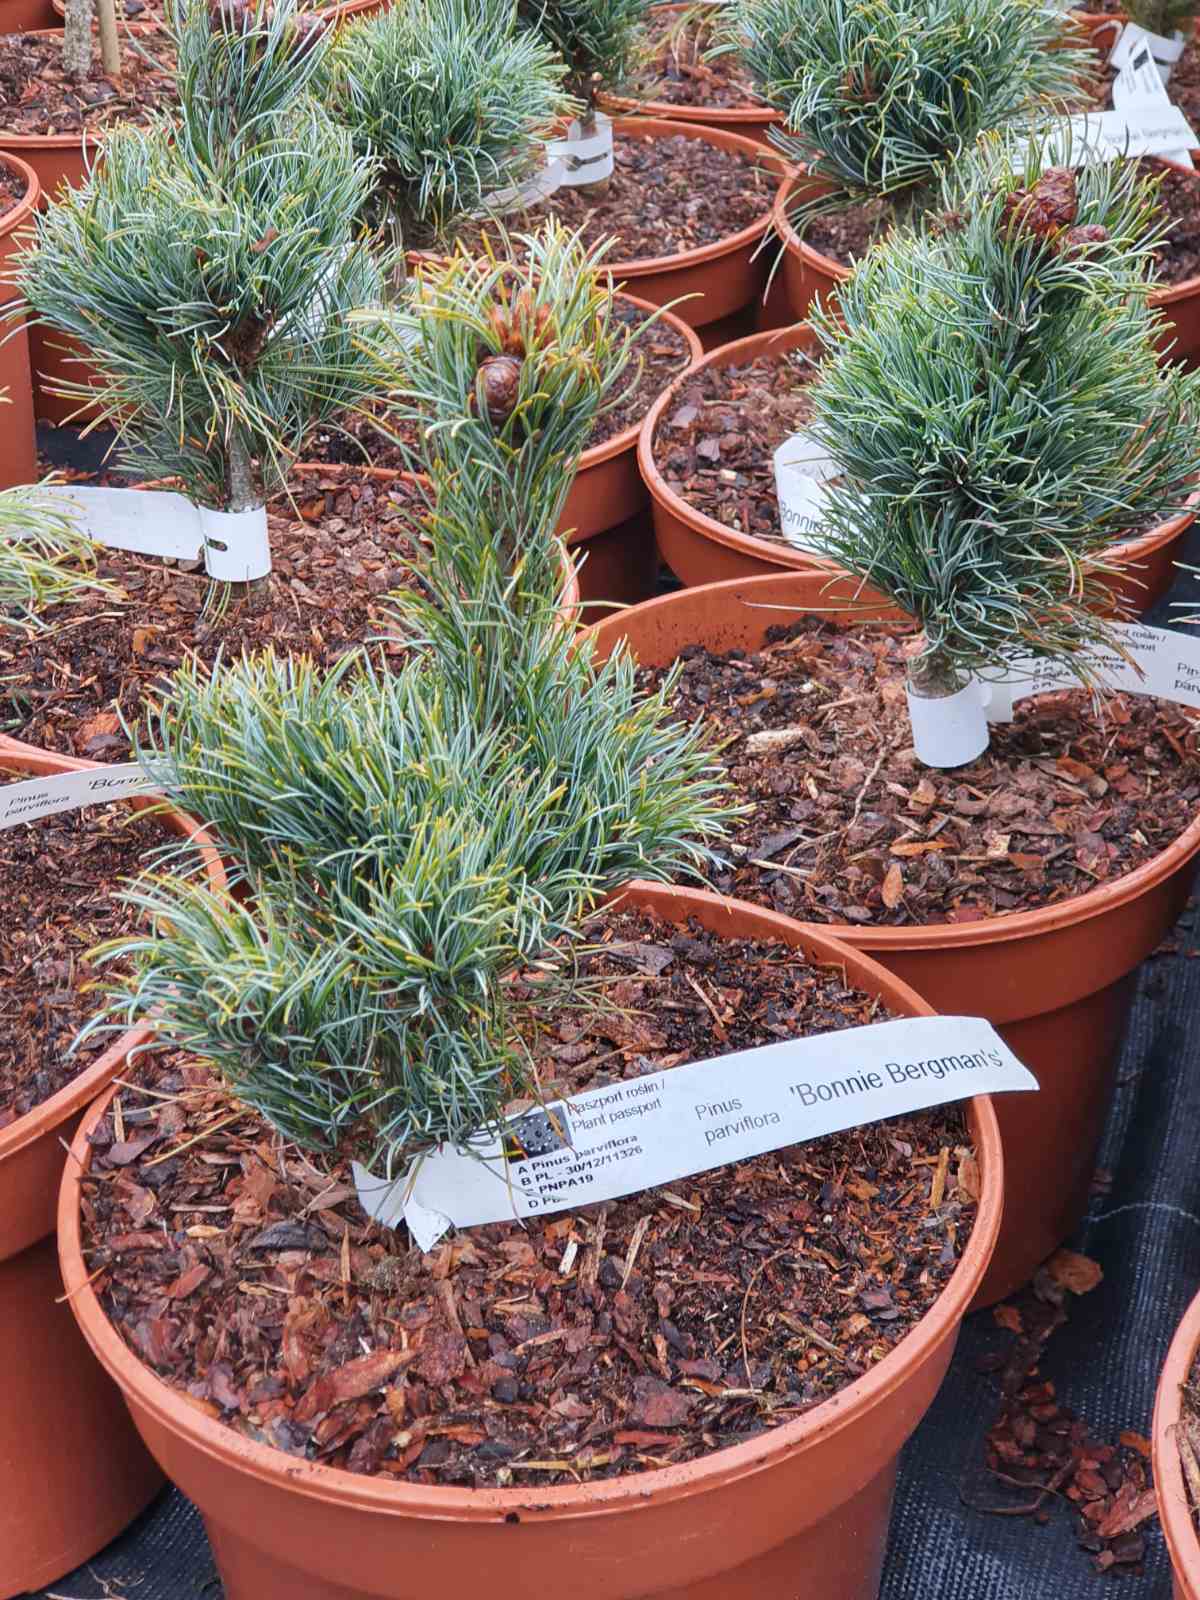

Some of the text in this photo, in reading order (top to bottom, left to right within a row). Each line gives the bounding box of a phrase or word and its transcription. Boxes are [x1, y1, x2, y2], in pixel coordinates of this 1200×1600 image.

[626, 1081, 659, 1099] roślin
[789, 1048, 1004, 1107] 'Bonnie Bergman's'
[571, 1097, 662, 1134] Plant passport
[694, 1096, 743, 1121] Pinus
[703, 1109, 781, 1146] parviflora
[517, 1134, 638, 1176] A Pinus parviflora
[520, 1176, 532, 1186] B
[535, 1172, 554, 1183] PL
[538, 1174, 595, 1194] PNPA19
[527, 1199, 539, 1209] D
